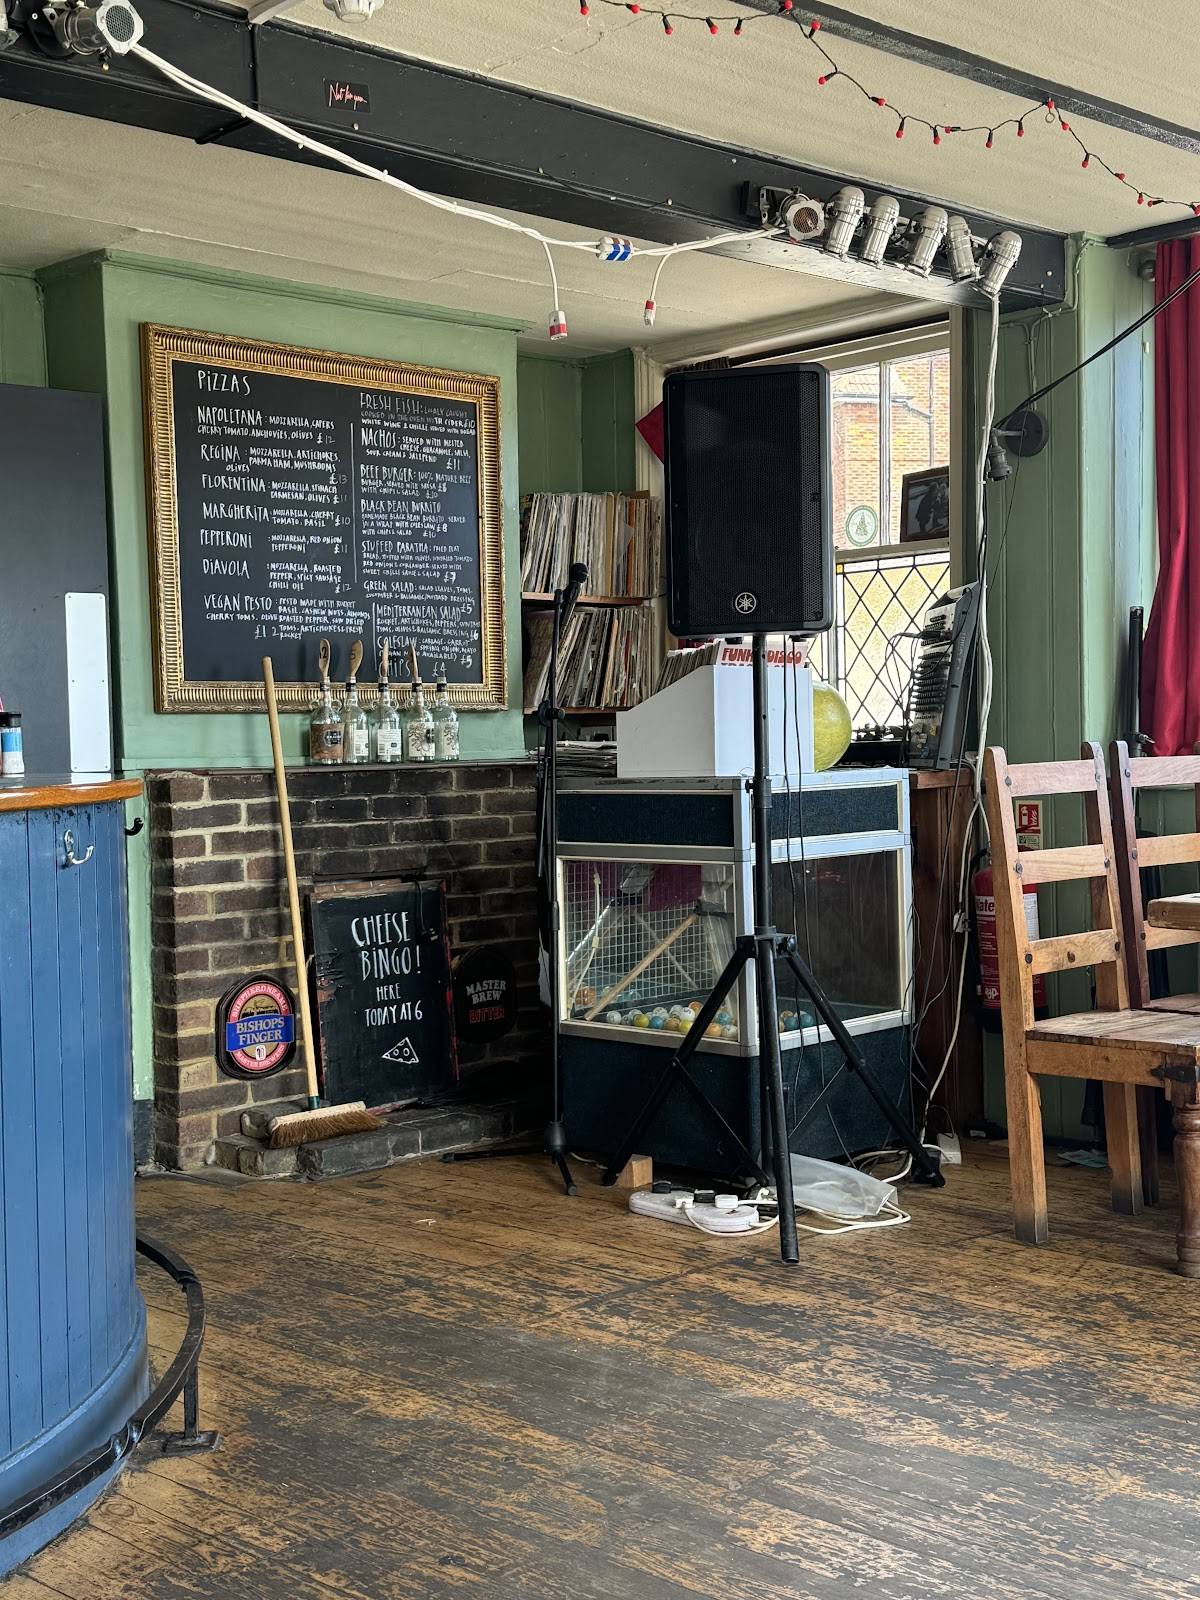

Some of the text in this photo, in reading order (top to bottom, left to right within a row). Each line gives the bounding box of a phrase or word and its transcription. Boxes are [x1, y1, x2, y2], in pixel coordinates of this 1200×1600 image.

[360, 392, 391, 411] FRESH
[312, 419, 335, 430] CAPERS
[361, 418, 382, 426] WHITE
[384, 420, 401, 428] WINE
[197, 424, 222, 436] CHERRY
[291, 430, 314, 440] OLIVES
[425, 437, 442, 446] WITH
[226, 462, 251, 473] OLIVES
[249, 456, 273, 467] PARMA
[294, 460, 337, 473] MUSHROOMS
[360, 464, 380, 479] BEEF
[311, 483, 337, 494] SPINACH
[308, 494, 331, 503] OLIVES
[361, 498, 385, 514] BLACK
[387, 500, 409, 513] BEAN
[304, 518, 326, 527] BASIL
[200, 528, 253, 549] PEPPERONI
[271, 543, 306, 554] PEPPERONI
[361, 540, 394, 554] STUFFED
[202, 558, 250, 579] DIAVOLA
[292, 582, 305, 591] OIL
[363, 579, 388, 592] GREEN
[203, 593, 241, 612] VEGAN
[206, 612, 234, 621] CHERRY
[440, 605, 462, 621] SALAD
[279, 632, 302, 641] ROCKET
[351, 911, 411, 947] CHEESE
[361, 945, 422, 981] BINGO!
[376, 982, 401, 1002] HERE
[466, 979, 507, 996] MASTER
[471, 990, 502, 1005] BREW
[365, 1000, 423, 1027] TODAY AT 6
[236, 1017, 285, 1034] BISHOPS
[239, 1030, 283, 1046] FINGER
